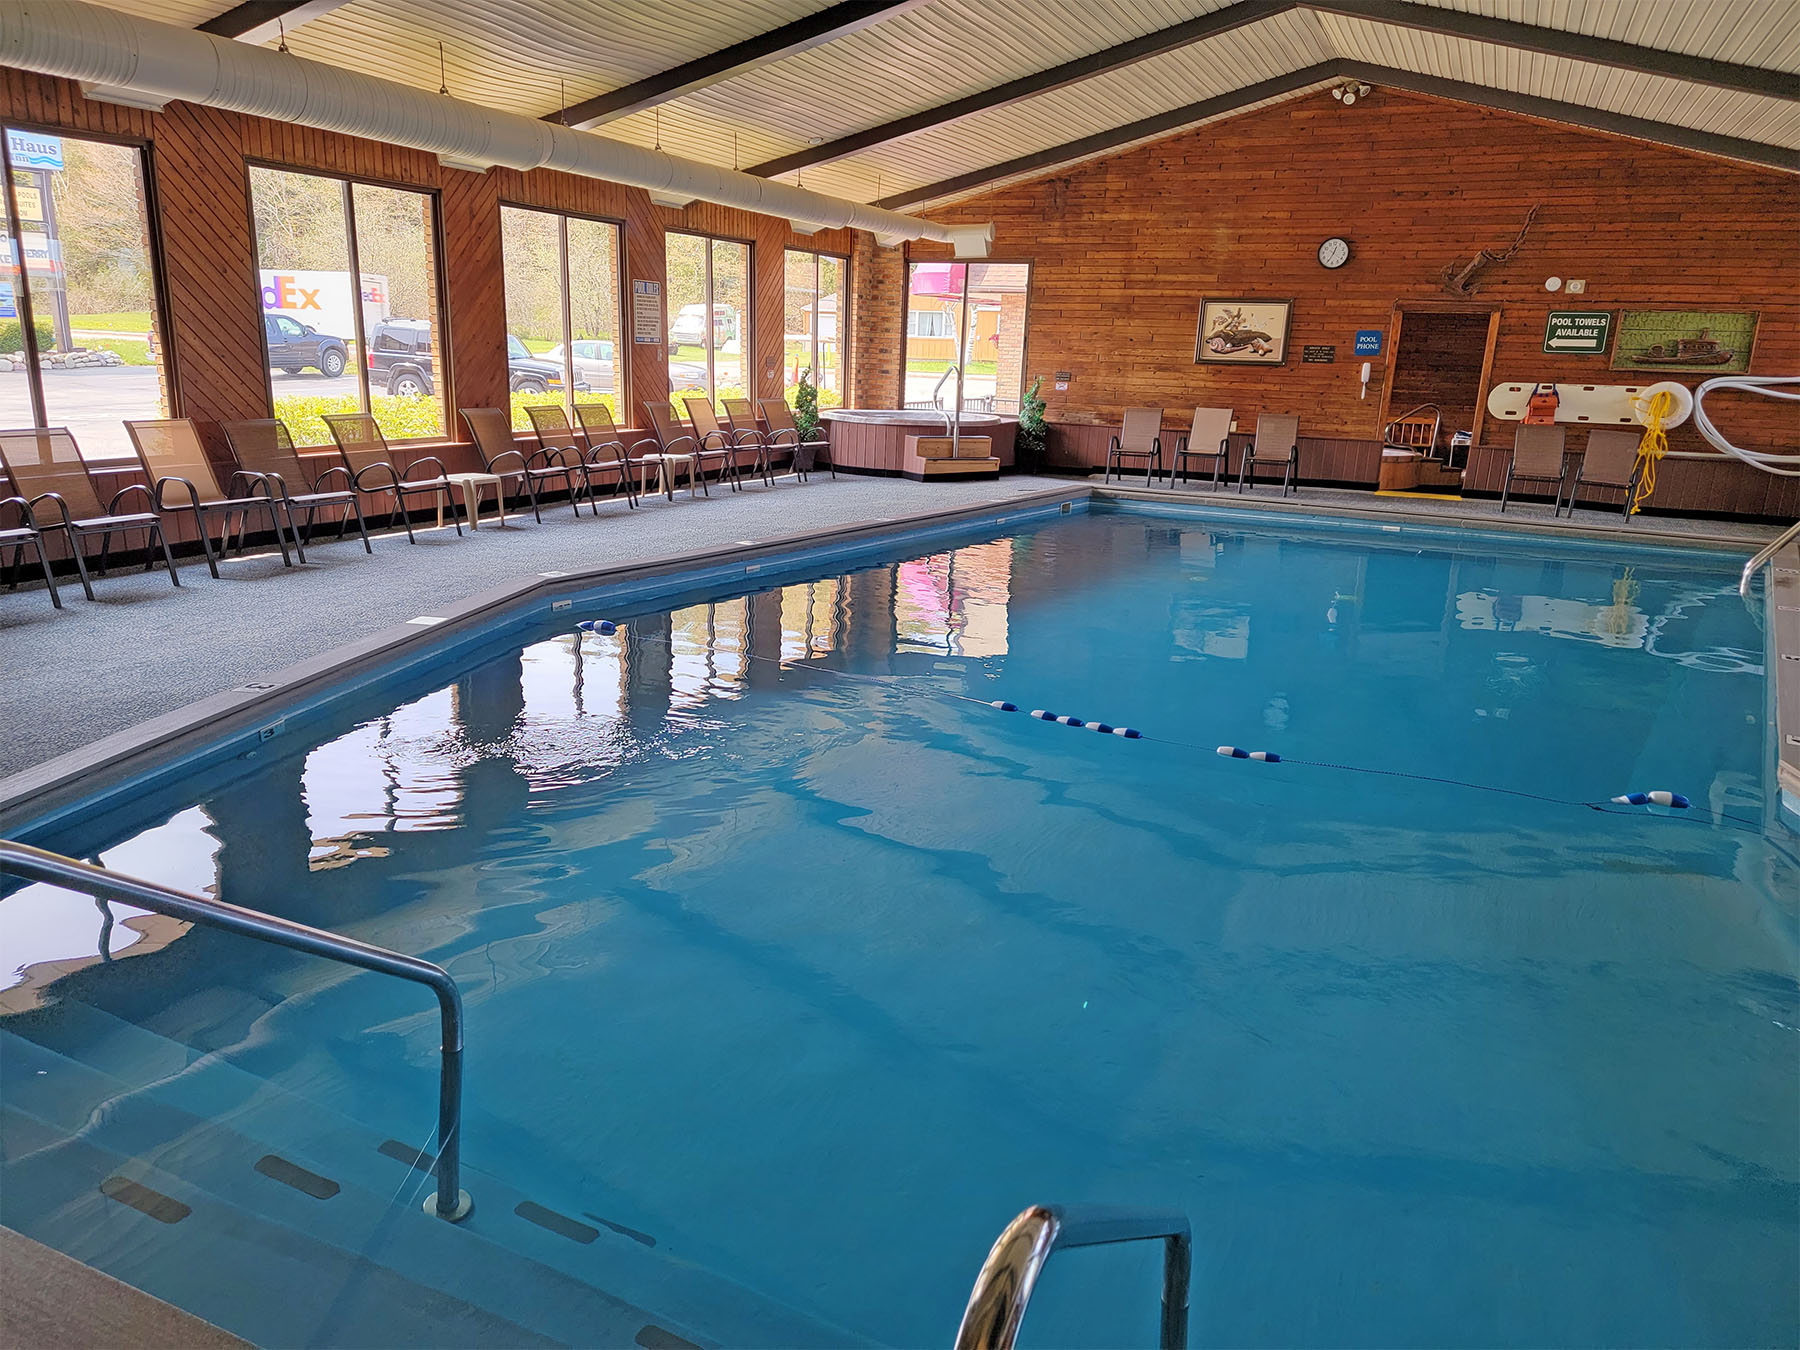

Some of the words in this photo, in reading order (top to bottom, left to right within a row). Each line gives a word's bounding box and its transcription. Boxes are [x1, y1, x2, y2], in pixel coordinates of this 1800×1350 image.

[11, 137, 57, 155] Haus
[263, 276, 322, 310] dEx
[1551, 318, 1573, 326] POOL
[1575, 318, 1607, 326] TOWELS
[1555, 328, 1599, 337] AVAILABLE
